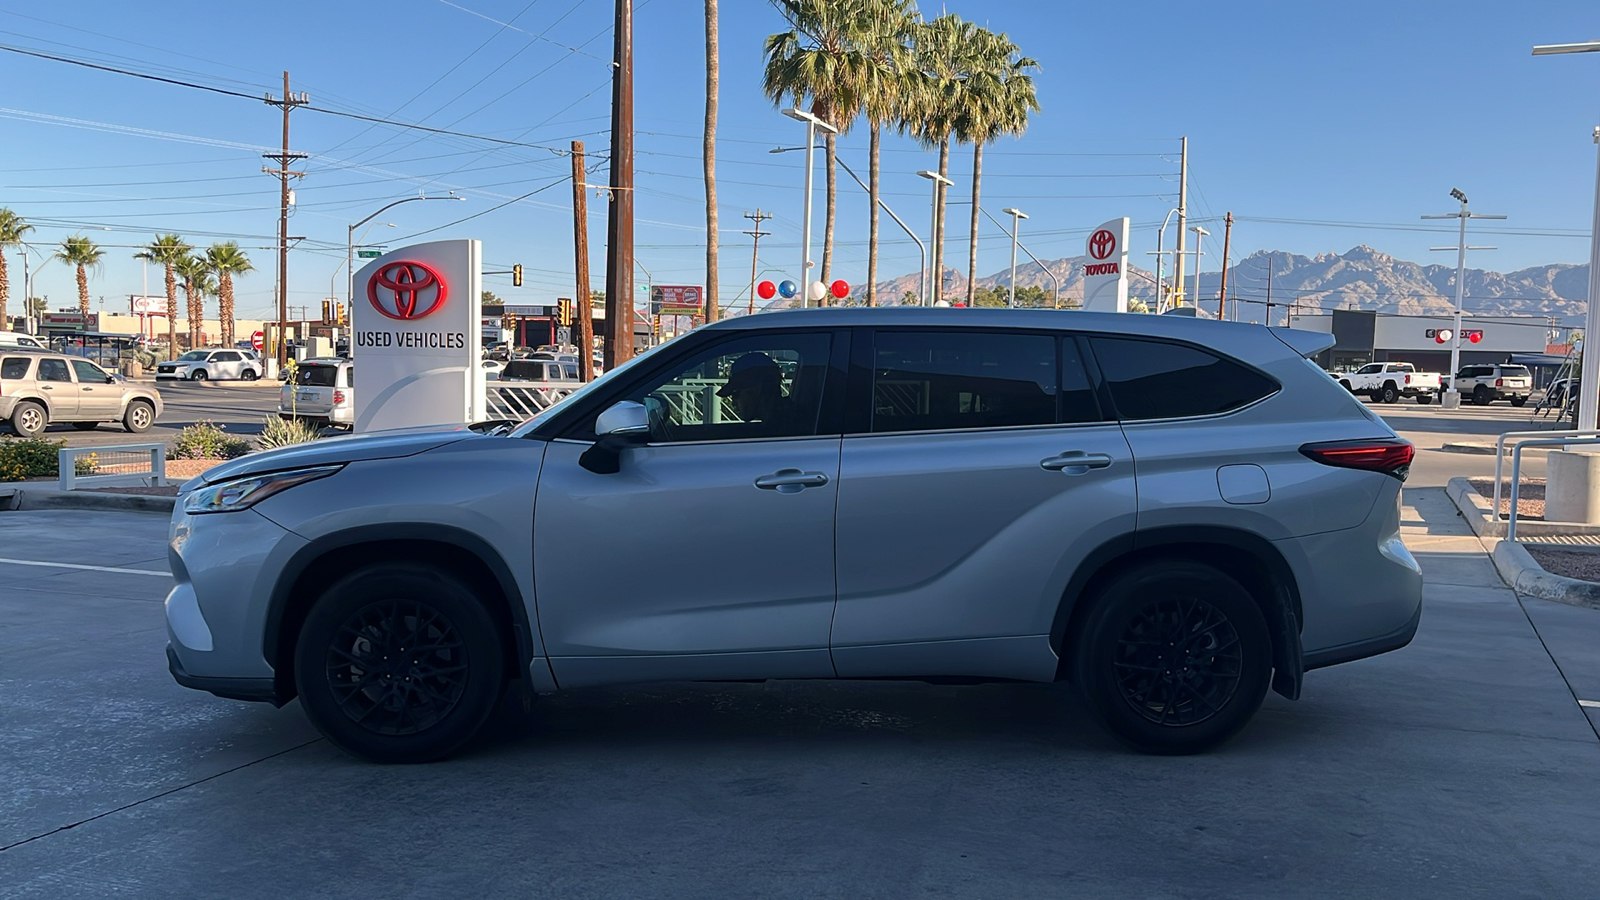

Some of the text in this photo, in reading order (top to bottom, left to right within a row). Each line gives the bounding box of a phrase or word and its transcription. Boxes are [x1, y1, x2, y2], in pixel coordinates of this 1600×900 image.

[1085, 263, 1119, 276] TOYOTA
[357, 331, 464, 348] USED VEHICLES
